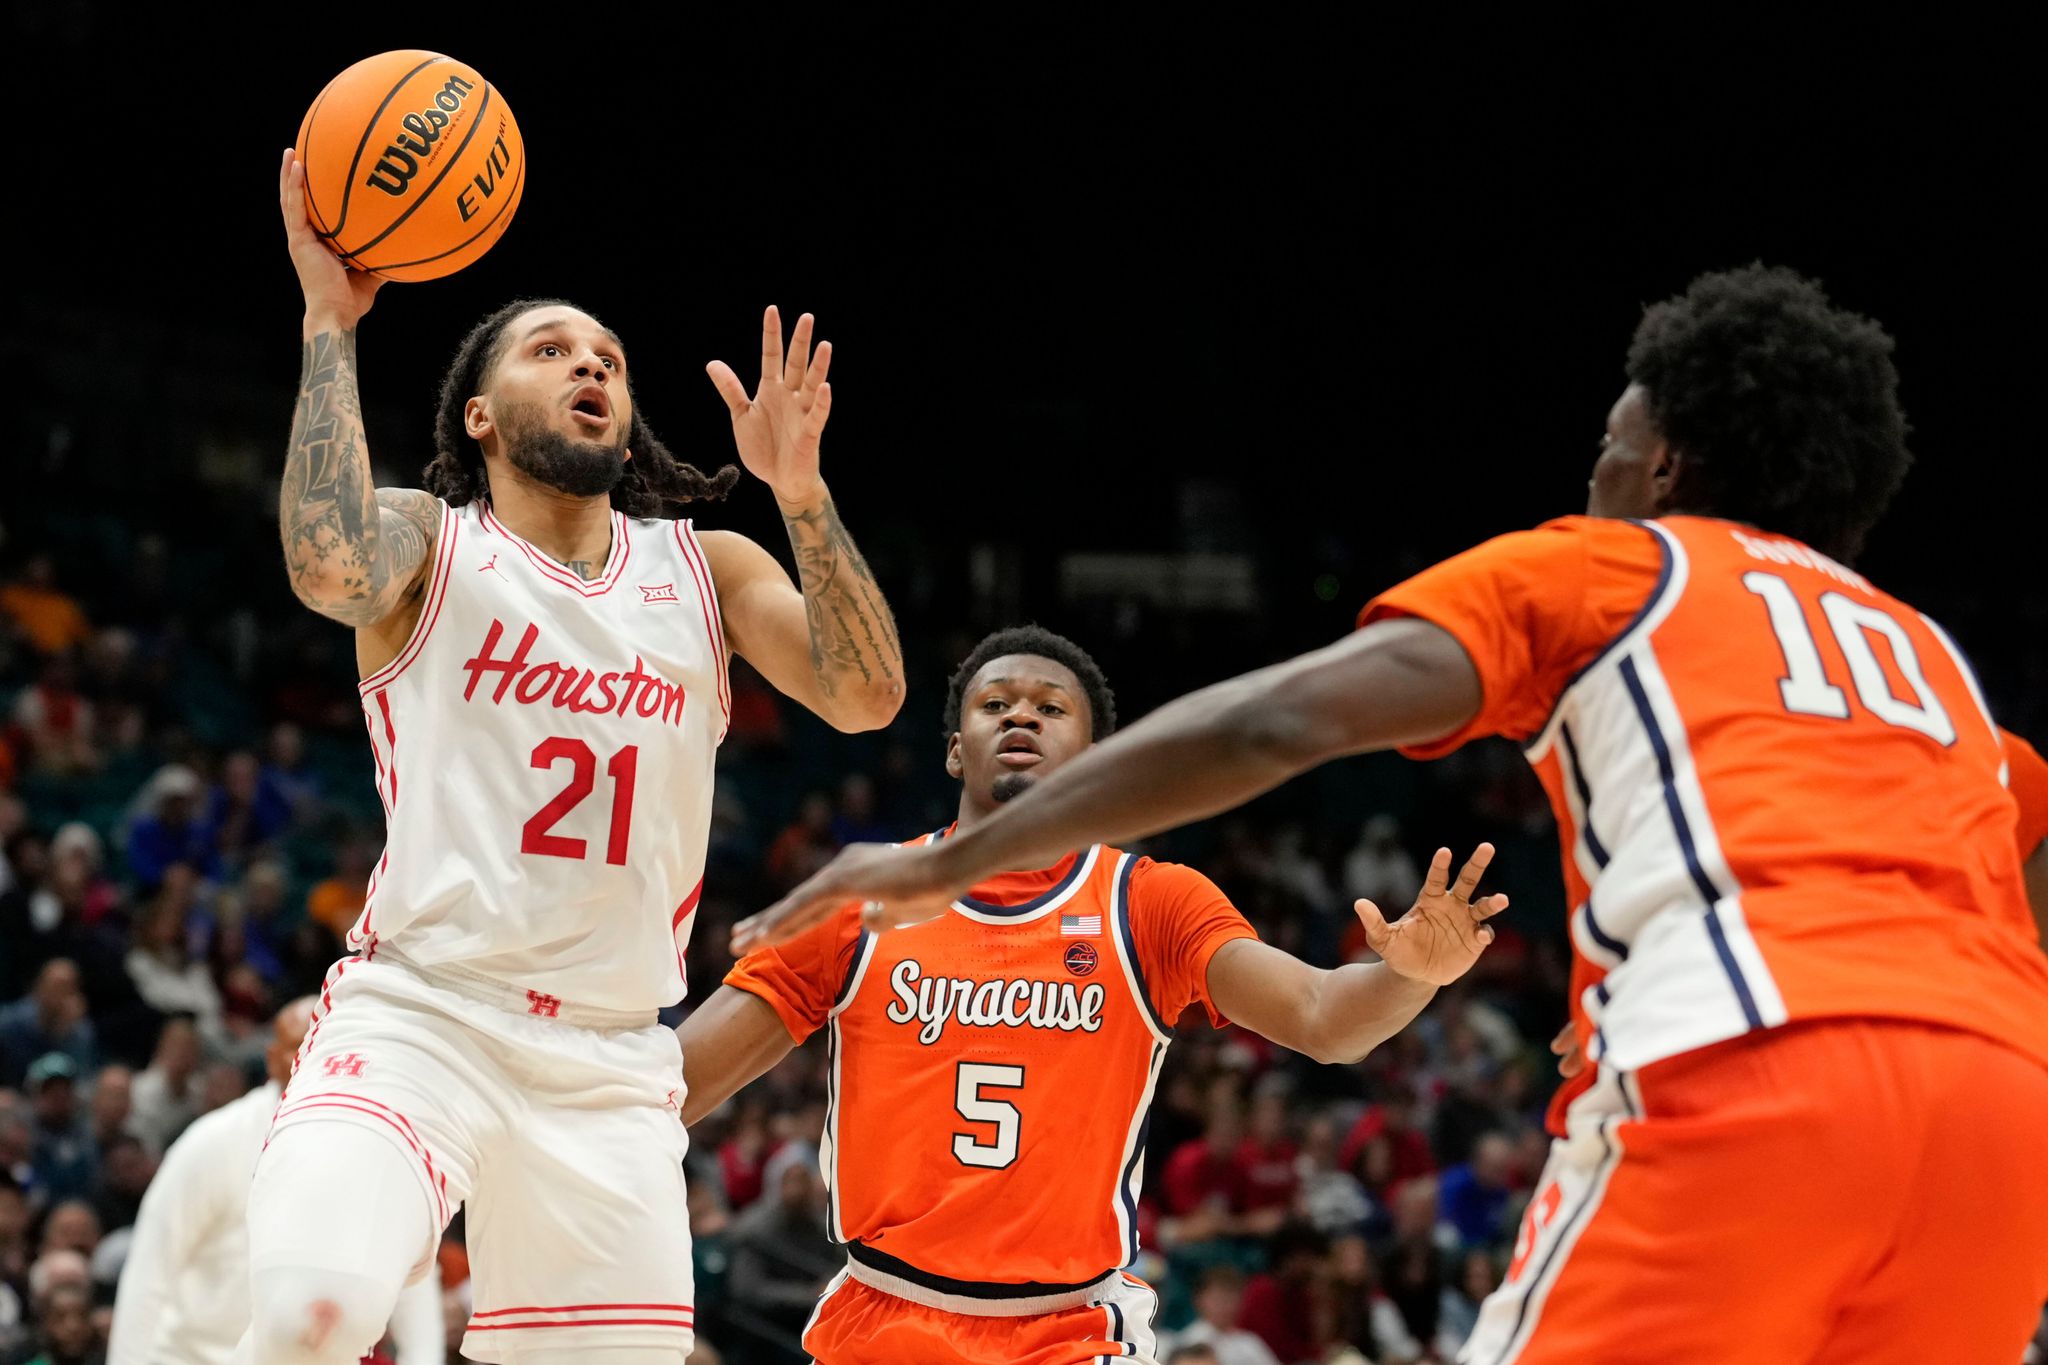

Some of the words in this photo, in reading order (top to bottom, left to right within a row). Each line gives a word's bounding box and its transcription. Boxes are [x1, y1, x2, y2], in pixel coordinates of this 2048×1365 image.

[366, 75, 474, 197] Wilson
[463, 618, 685, 728] Houston
[1741, 571, 1957, 748] 10
[521, 736, 638, 866] 21
[886, 959, 1105, 1045] Syracuse
[951, 1060, 1025, 1170] 5
